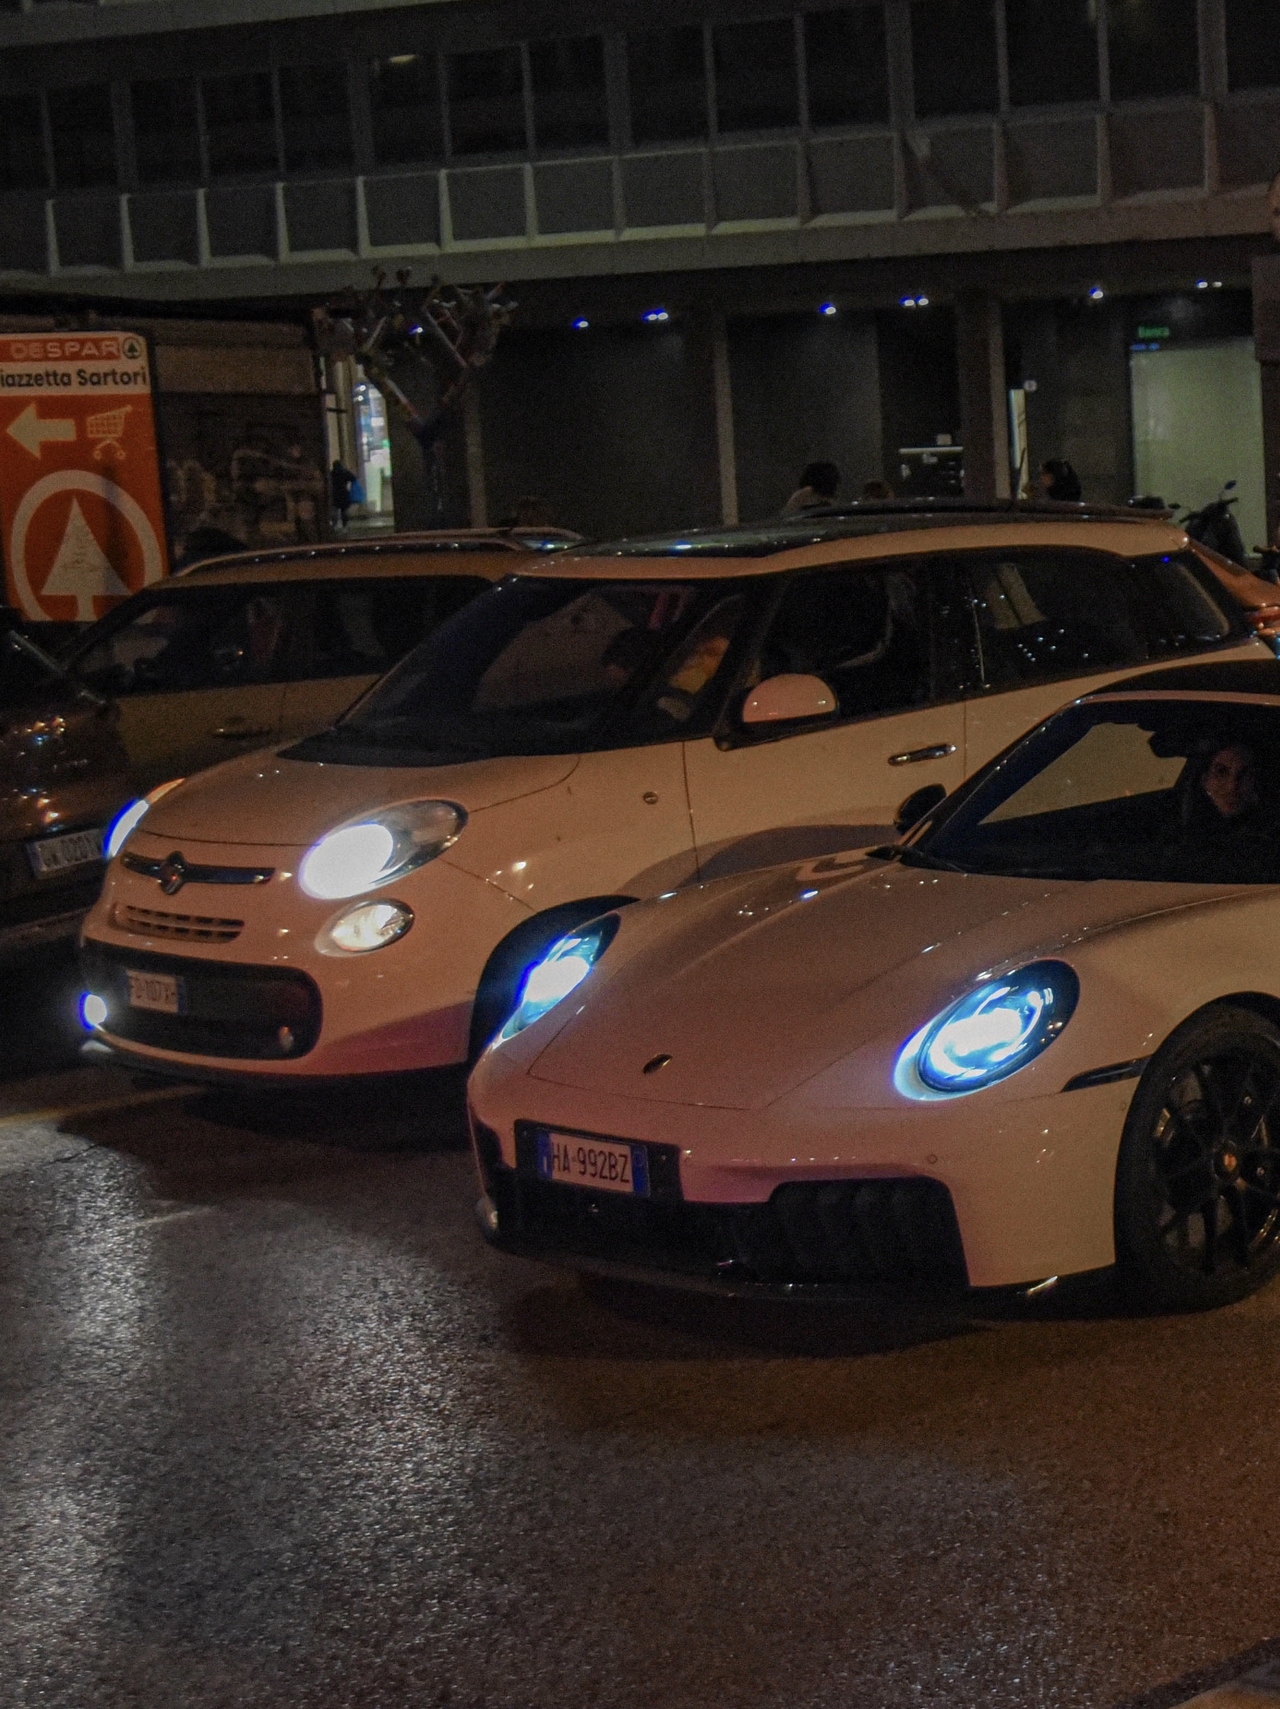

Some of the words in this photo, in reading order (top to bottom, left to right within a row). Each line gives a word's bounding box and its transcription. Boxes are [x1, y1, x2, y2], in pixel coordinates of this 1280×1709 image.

[9, 340, 120, 359] DESPAR
[0, 368, 72, 388] iazzetta
[76, 366, 148, 386] Sartori
[577, 1146, 630, 1183] 992BZ
